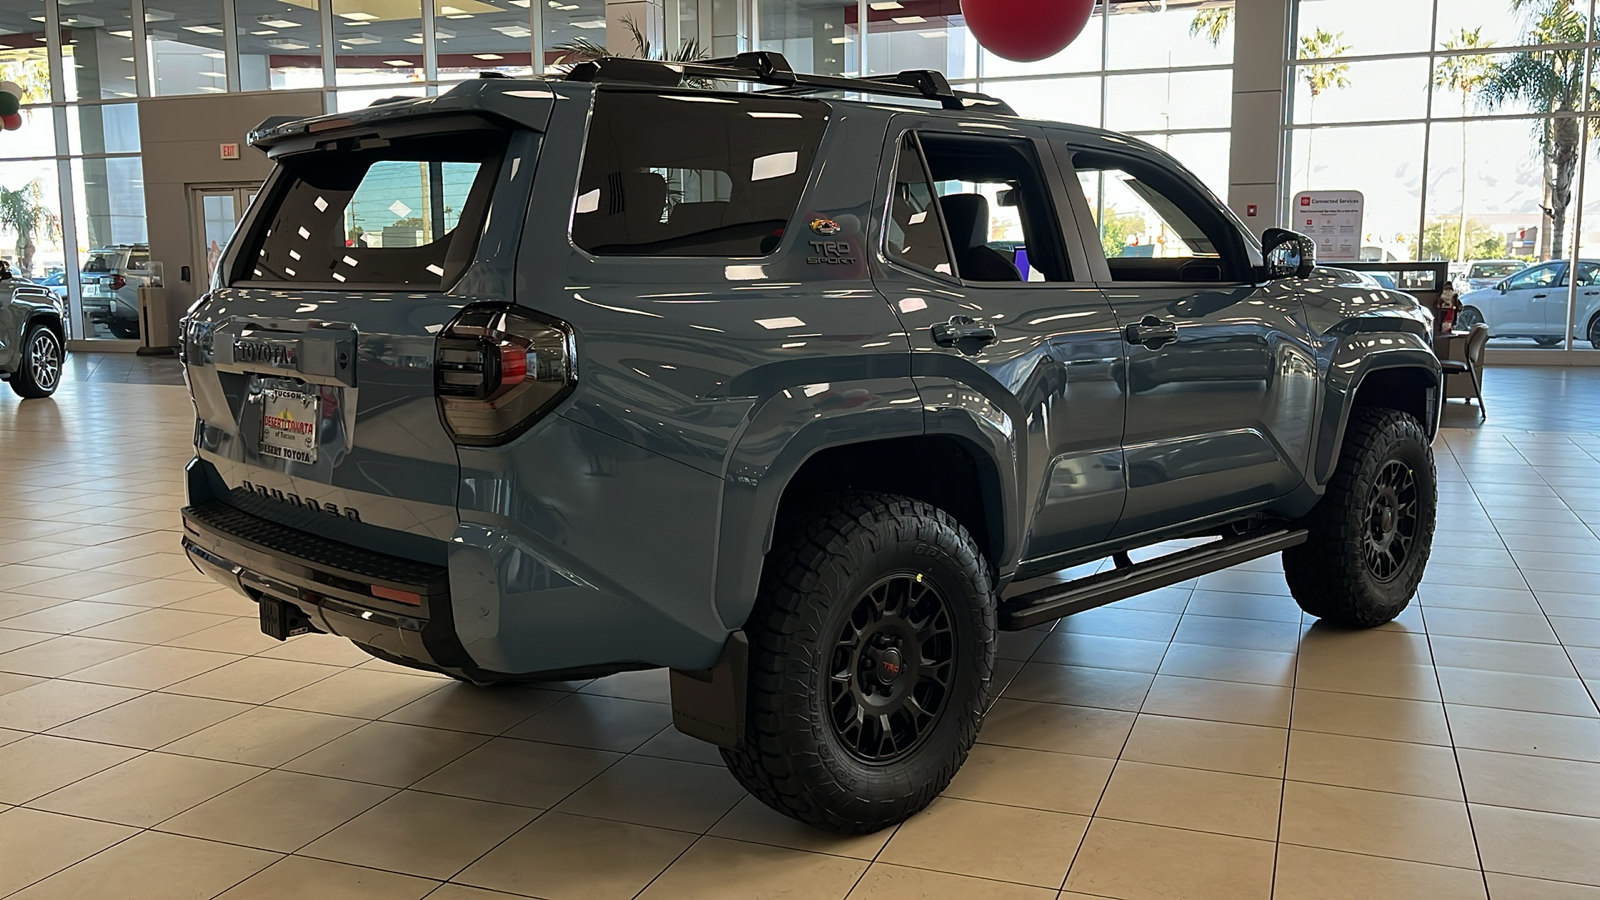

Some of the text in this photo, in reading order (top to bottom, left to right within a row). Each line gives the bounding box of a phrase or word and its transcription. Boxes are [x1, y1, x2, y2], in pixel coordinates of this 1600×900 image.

[223, 145, 235, 156] EXIT
[808, 240, 850, 257] TRD
[806, 256, 856, 264] SPORT
[240, 341, 289, 365] TOYOTA
[274, 390, 302, 400] TUCSON
[264, 415, 286, 429] DESERT
[281, 432, 296, 441] Tucson
[283, 448, 311, 463] TOYOTA
[882, 661, 899, 673] TRD
